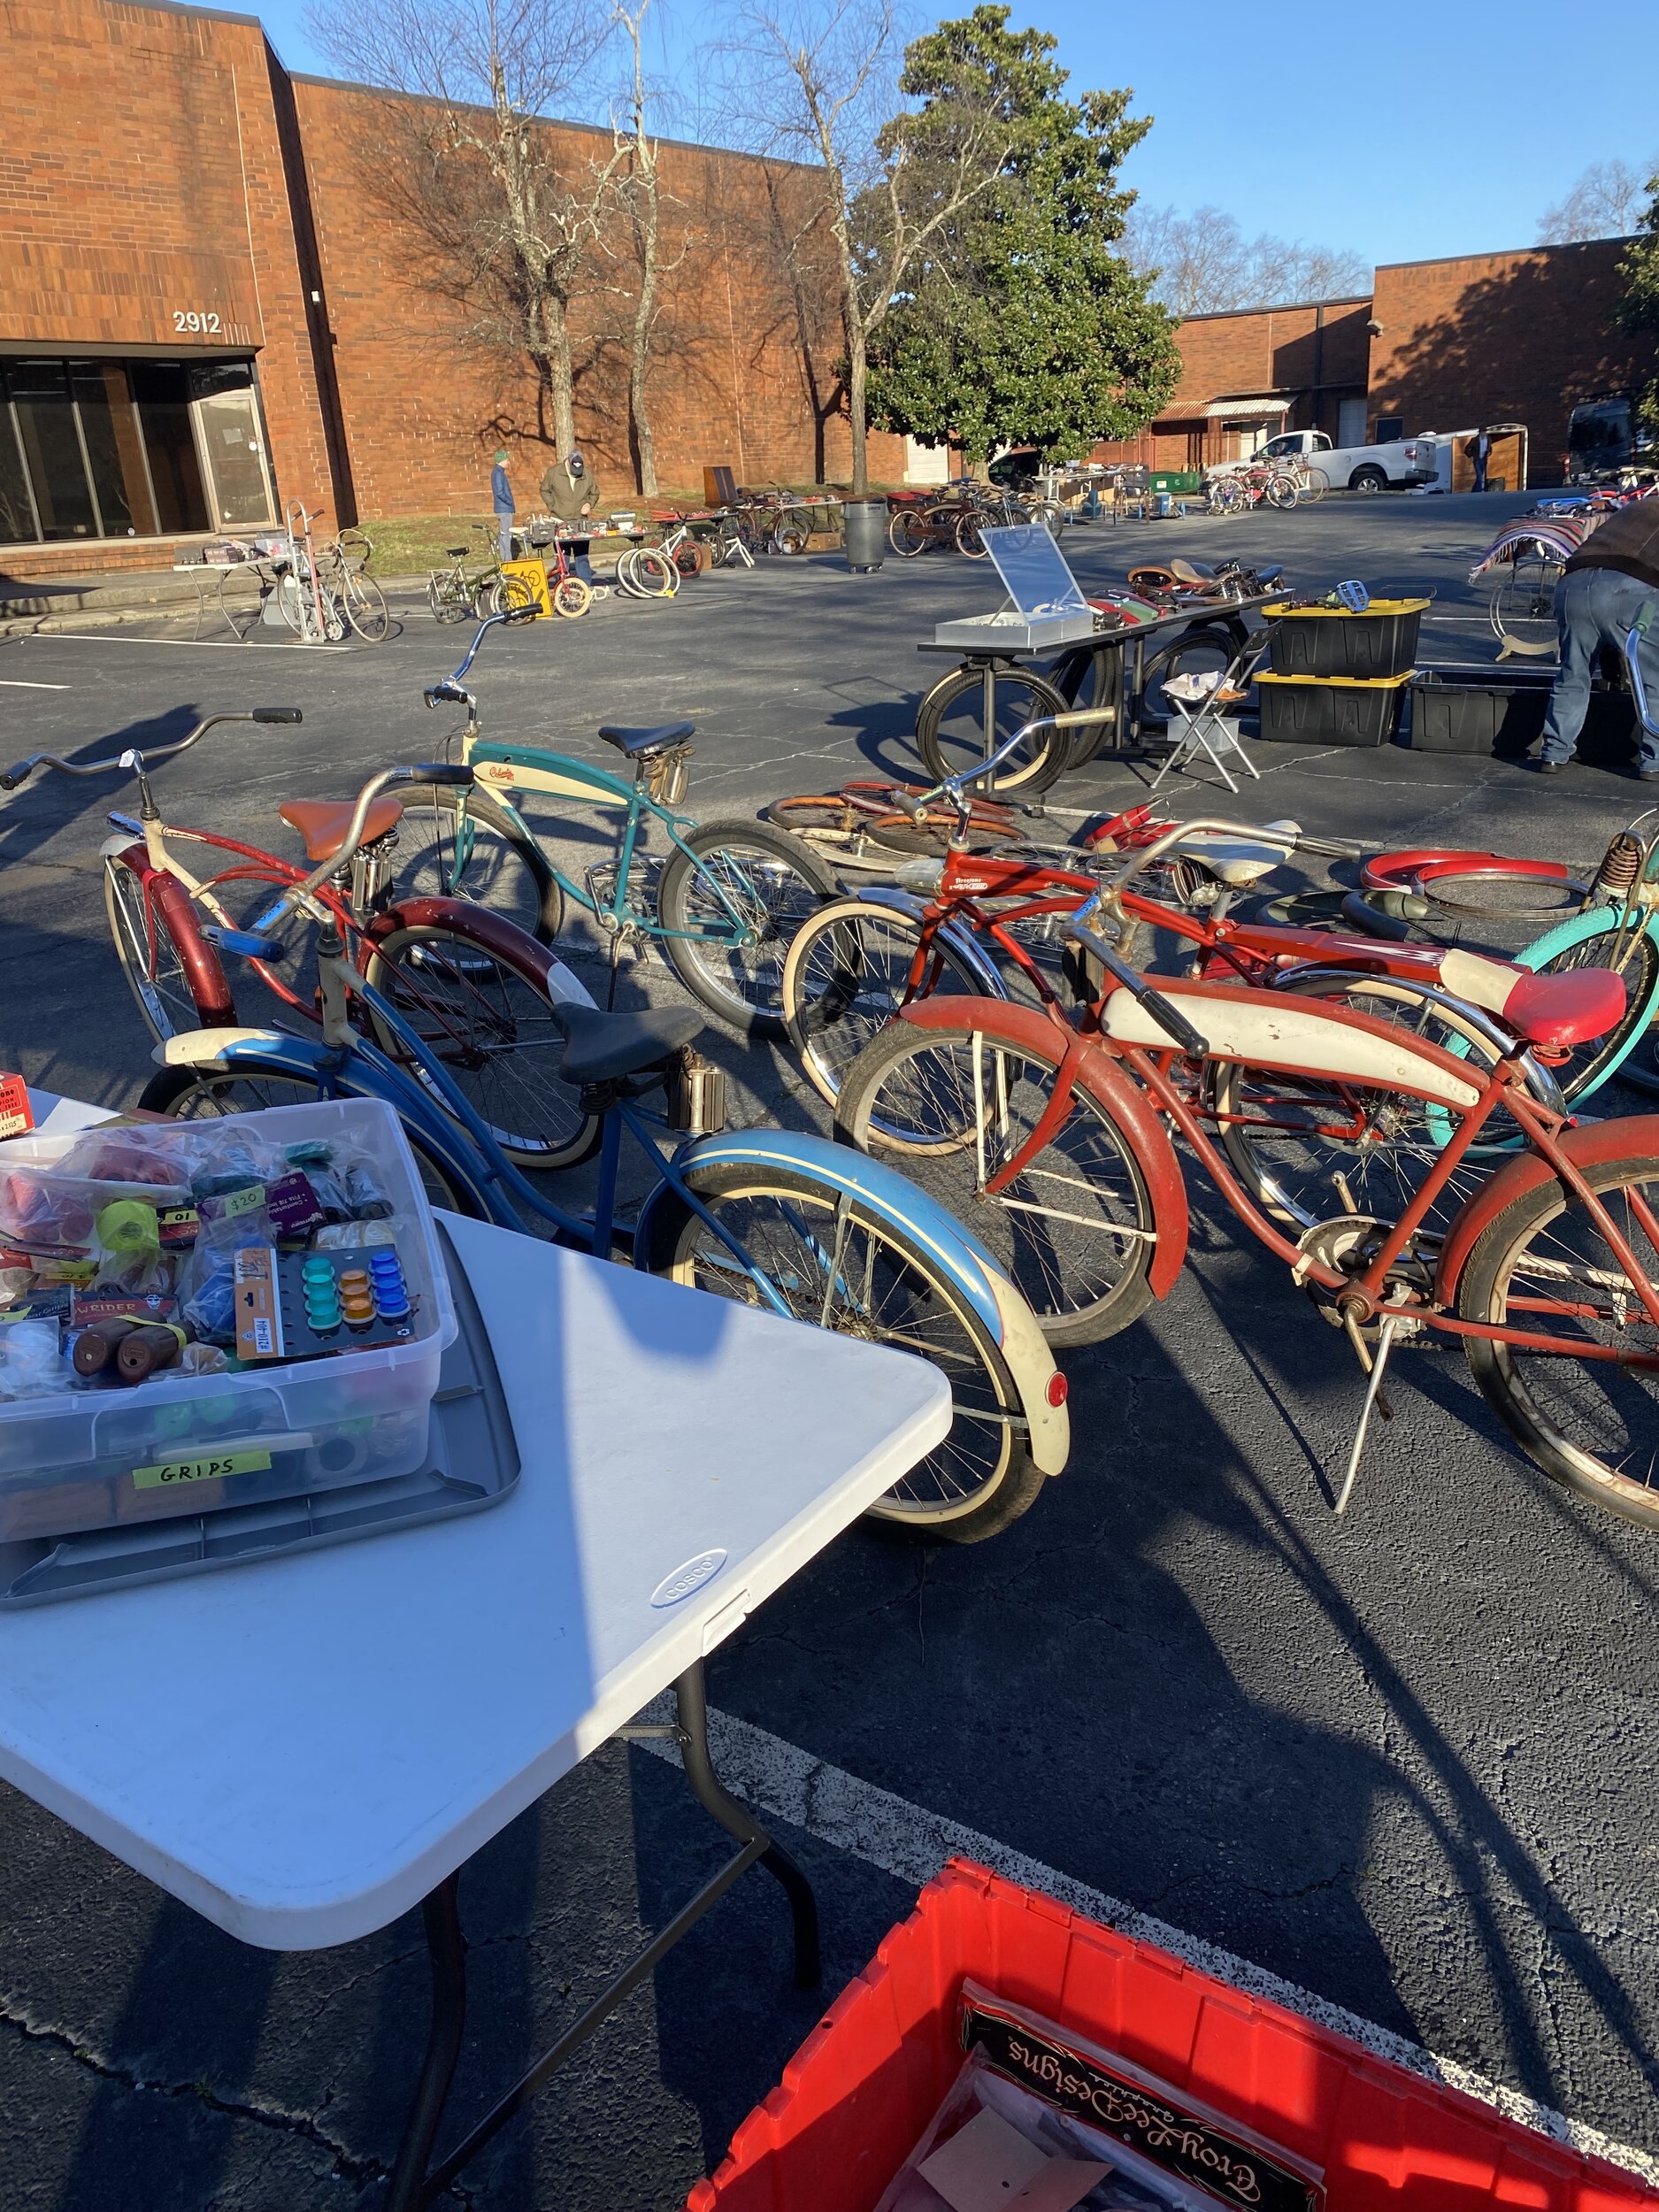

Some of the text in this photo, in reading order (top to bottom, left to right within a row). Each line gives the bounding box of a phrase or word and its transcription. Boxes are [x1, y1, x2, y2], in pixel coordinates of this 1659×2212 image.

[173, 311, 222, 334] 2912
[230, 1193, 257, 1211] $20
[174, 1212, 190, 1221] 10
[160, 1459, 234, 1482] GRIPS
[665, 1561, 714, 1600] COSCO
